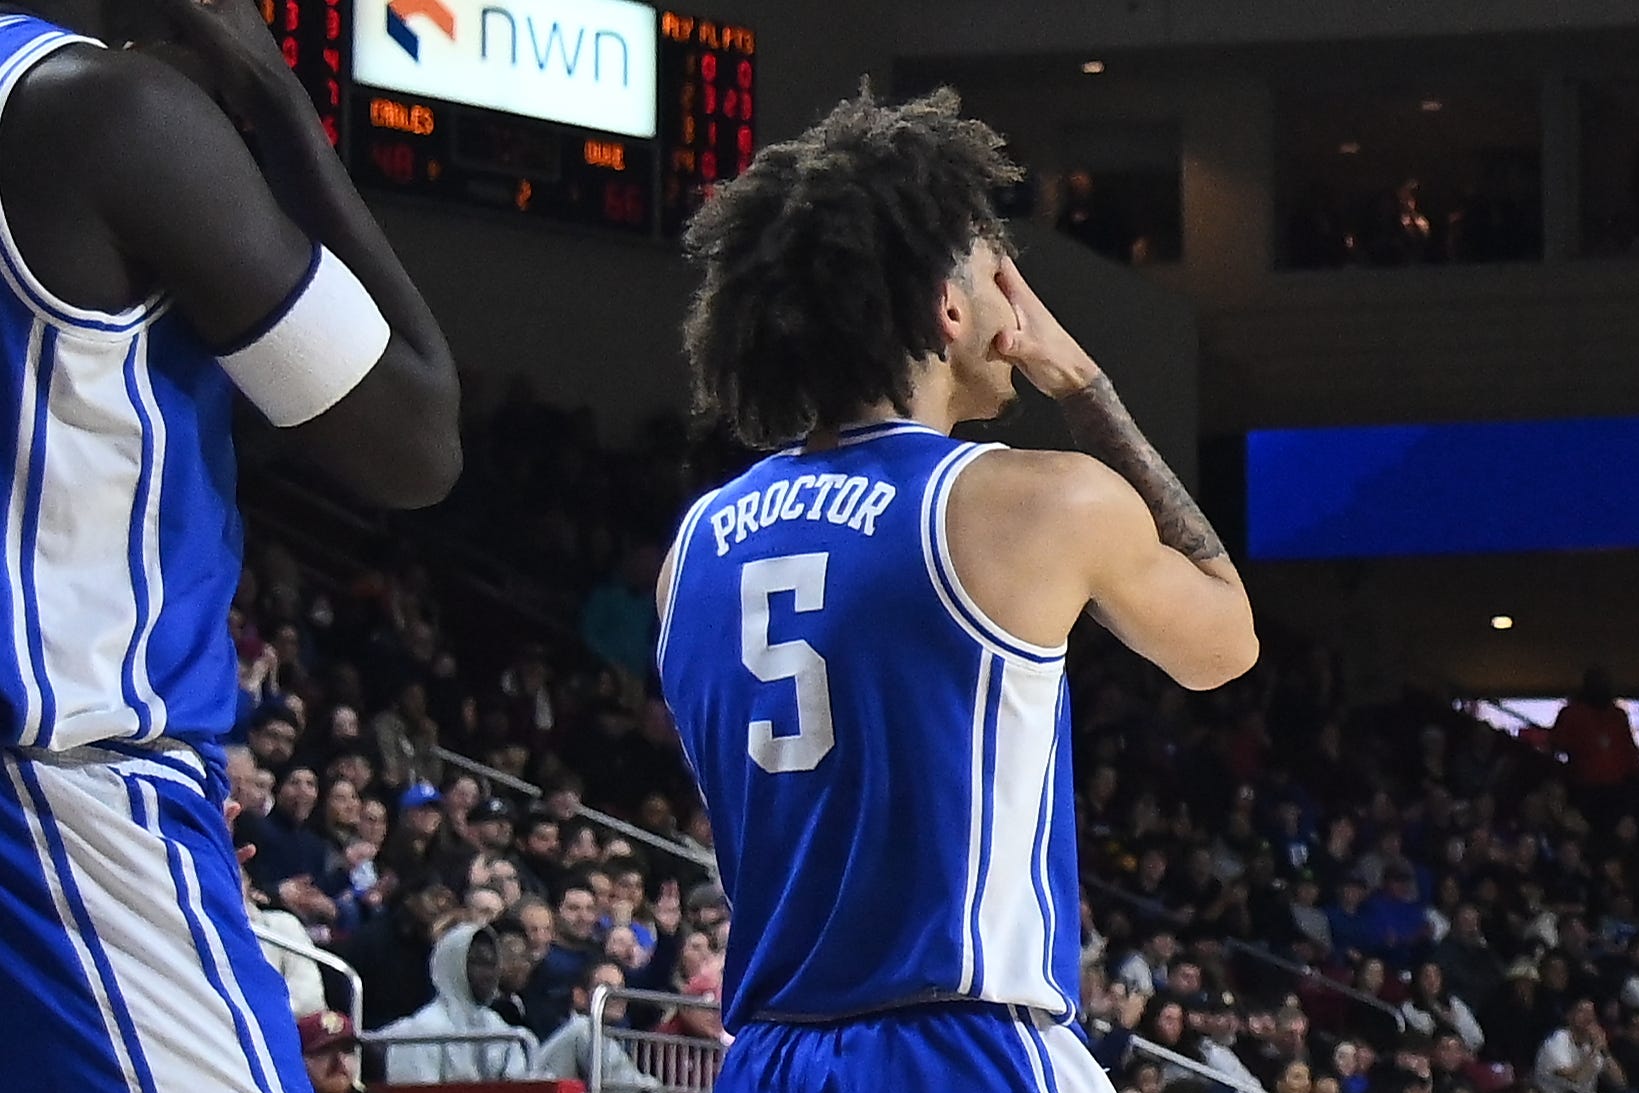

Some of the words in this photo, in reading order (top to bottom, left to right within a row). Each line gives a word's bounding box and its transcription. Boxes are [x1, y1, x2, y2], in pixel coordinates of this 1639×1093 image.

[480, 6, 629, 87] nwn
[711, 474, 896, 556] PROCTOR
[740, 552, 835, 774] 5
